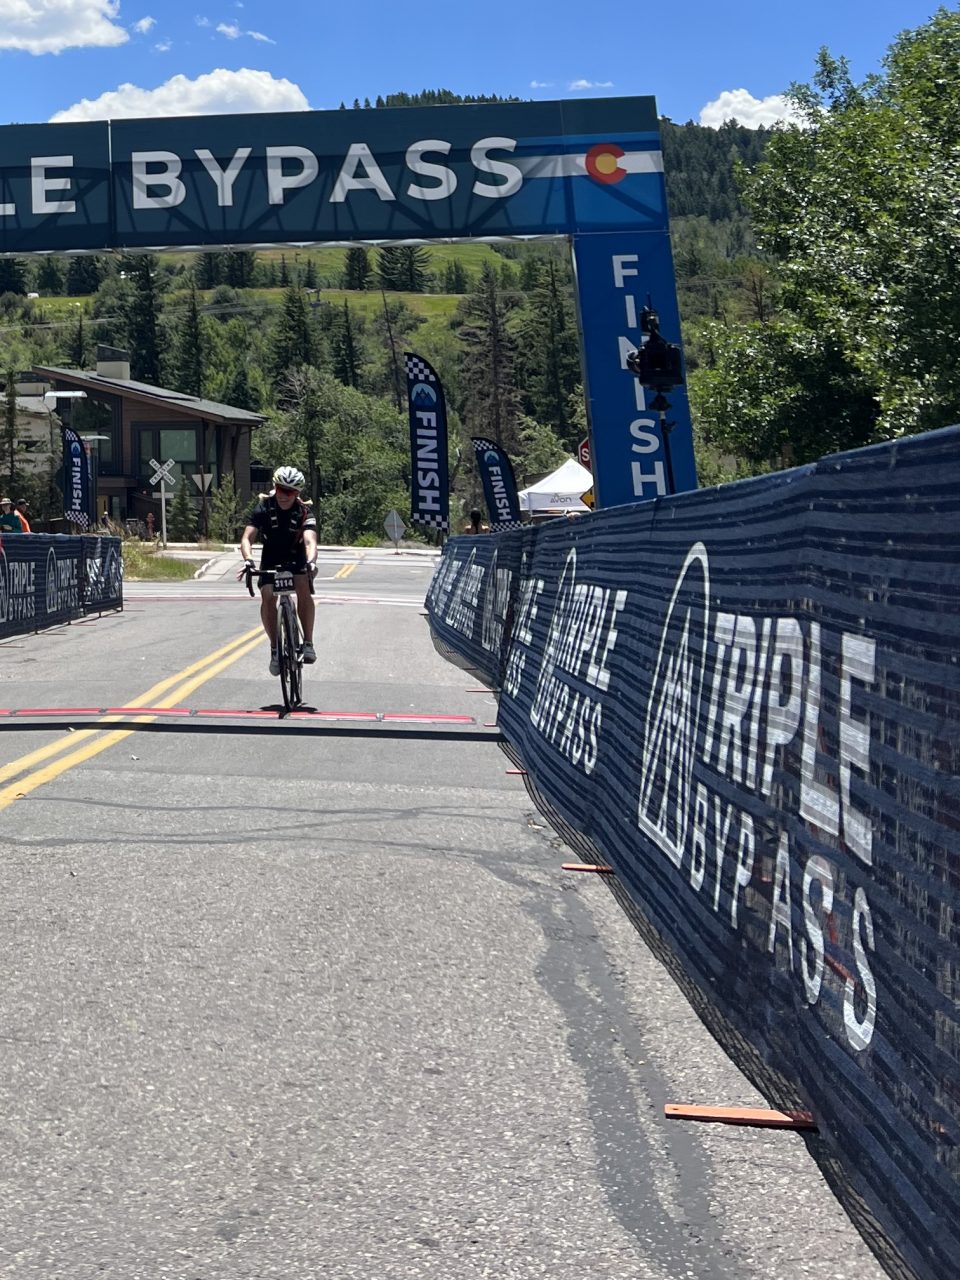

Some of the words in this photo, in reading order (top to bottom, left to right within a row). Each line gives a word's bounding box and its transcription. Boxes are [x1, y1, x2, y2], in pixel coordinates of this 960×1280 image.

[131, 136, 523, 209] BYPASS
[72, 457, 82, 510] FINISH
[416, 411, 440, 511] FINISH
[488, 465, 512, 520] FINISH
[9, 562, 35, 594] TRIPLE
[275, 579, 294, 588] 3114
[8, 596, 35, 621] BYPASS
[703, 612, 877, 866] TRIPLE
[690, 782, 877, 1052] BYPASS
